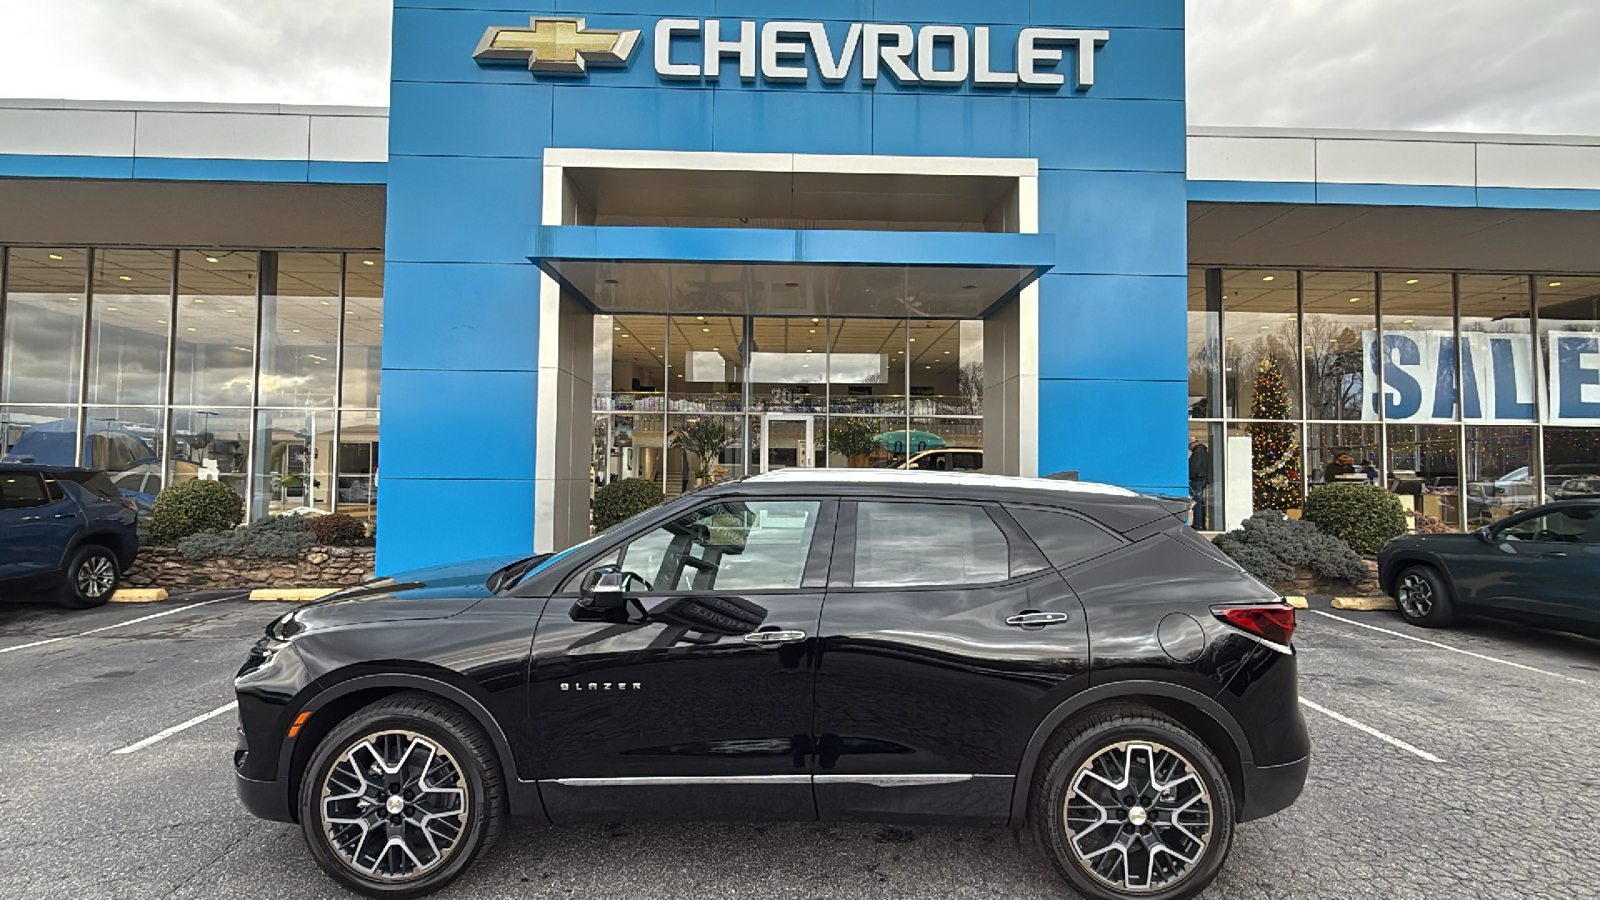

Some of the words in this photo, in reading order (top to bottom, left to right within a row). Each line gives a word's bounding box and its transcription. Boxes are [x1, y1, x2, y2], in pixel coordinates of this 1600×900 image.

[655, 18, 1110, 91] CHEVROLET
[1370, 334, 1600, 420] SALE
[560, 682, 642, 691] BLAZER
